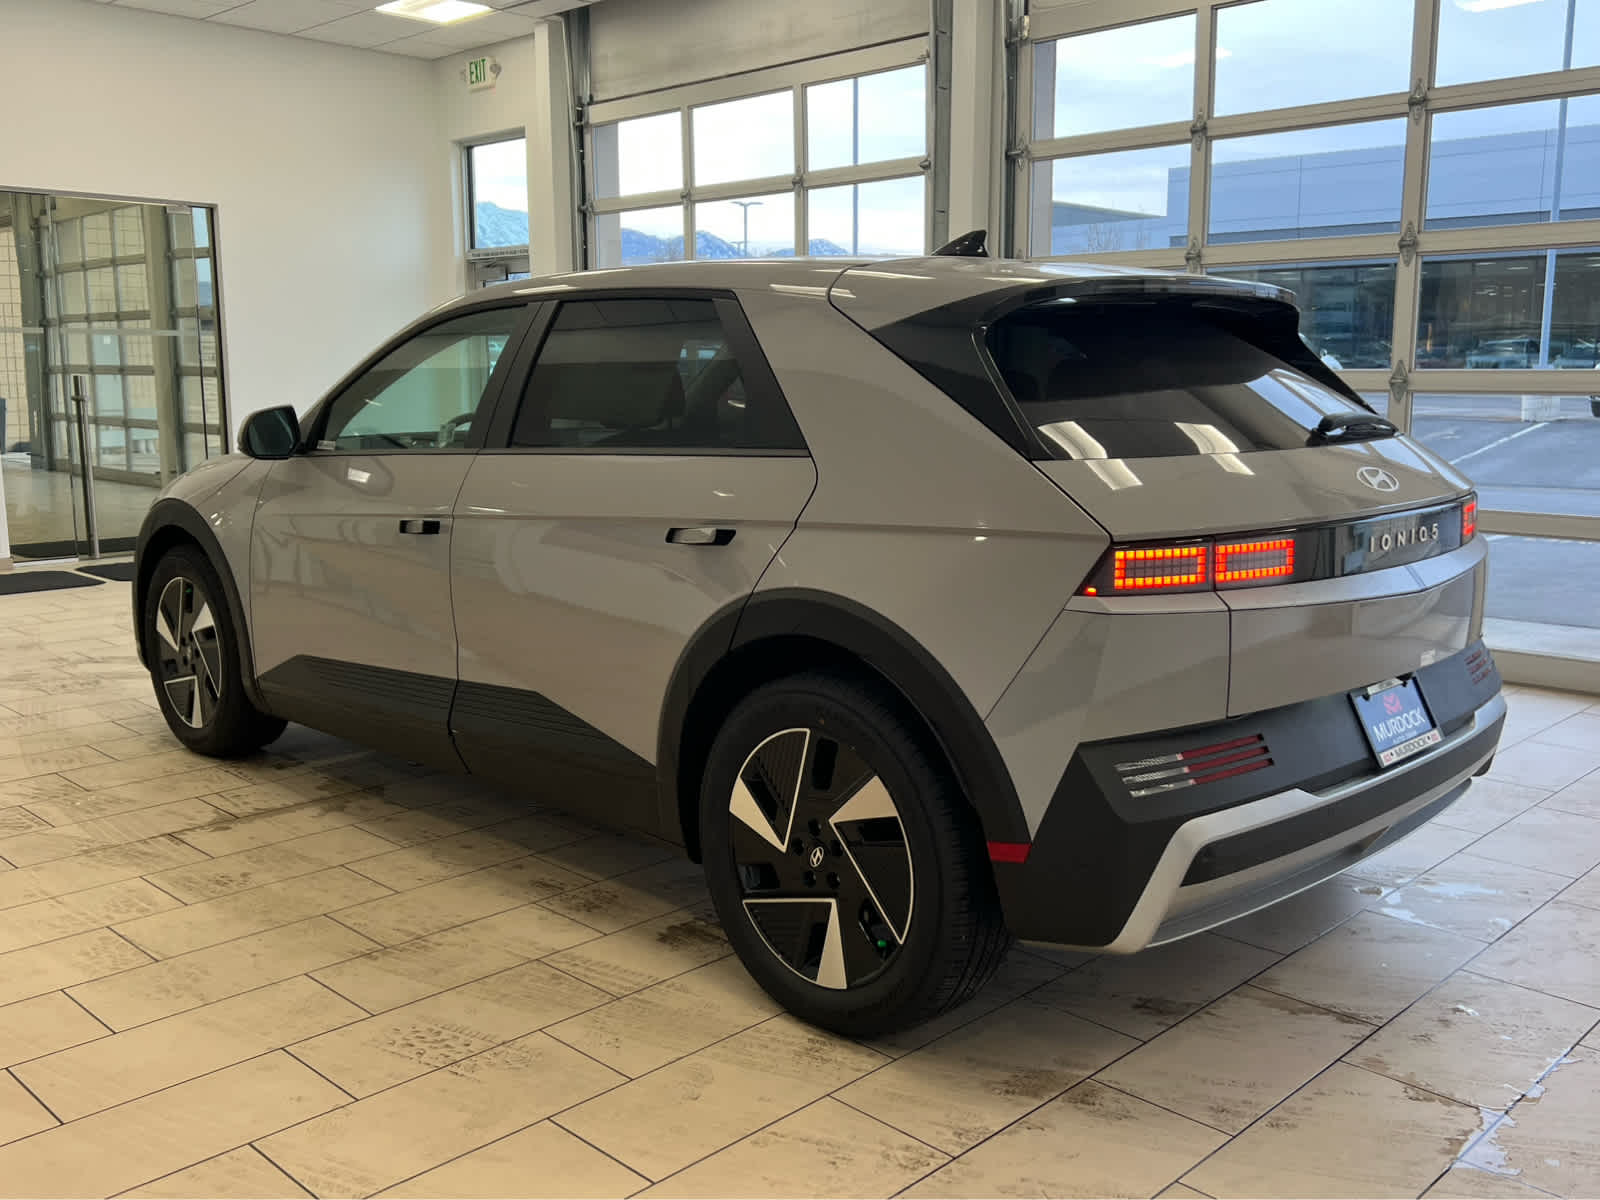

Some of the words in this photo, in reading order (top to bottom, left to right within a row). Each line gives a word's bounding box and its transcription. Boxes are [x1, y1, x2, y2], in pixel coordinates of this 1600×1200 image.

[469, 58, 486, 84] EXIT
[1372, 707, 1426, 742] MURDOCK
[1394, 737, 1430, 758] MURDOCK
